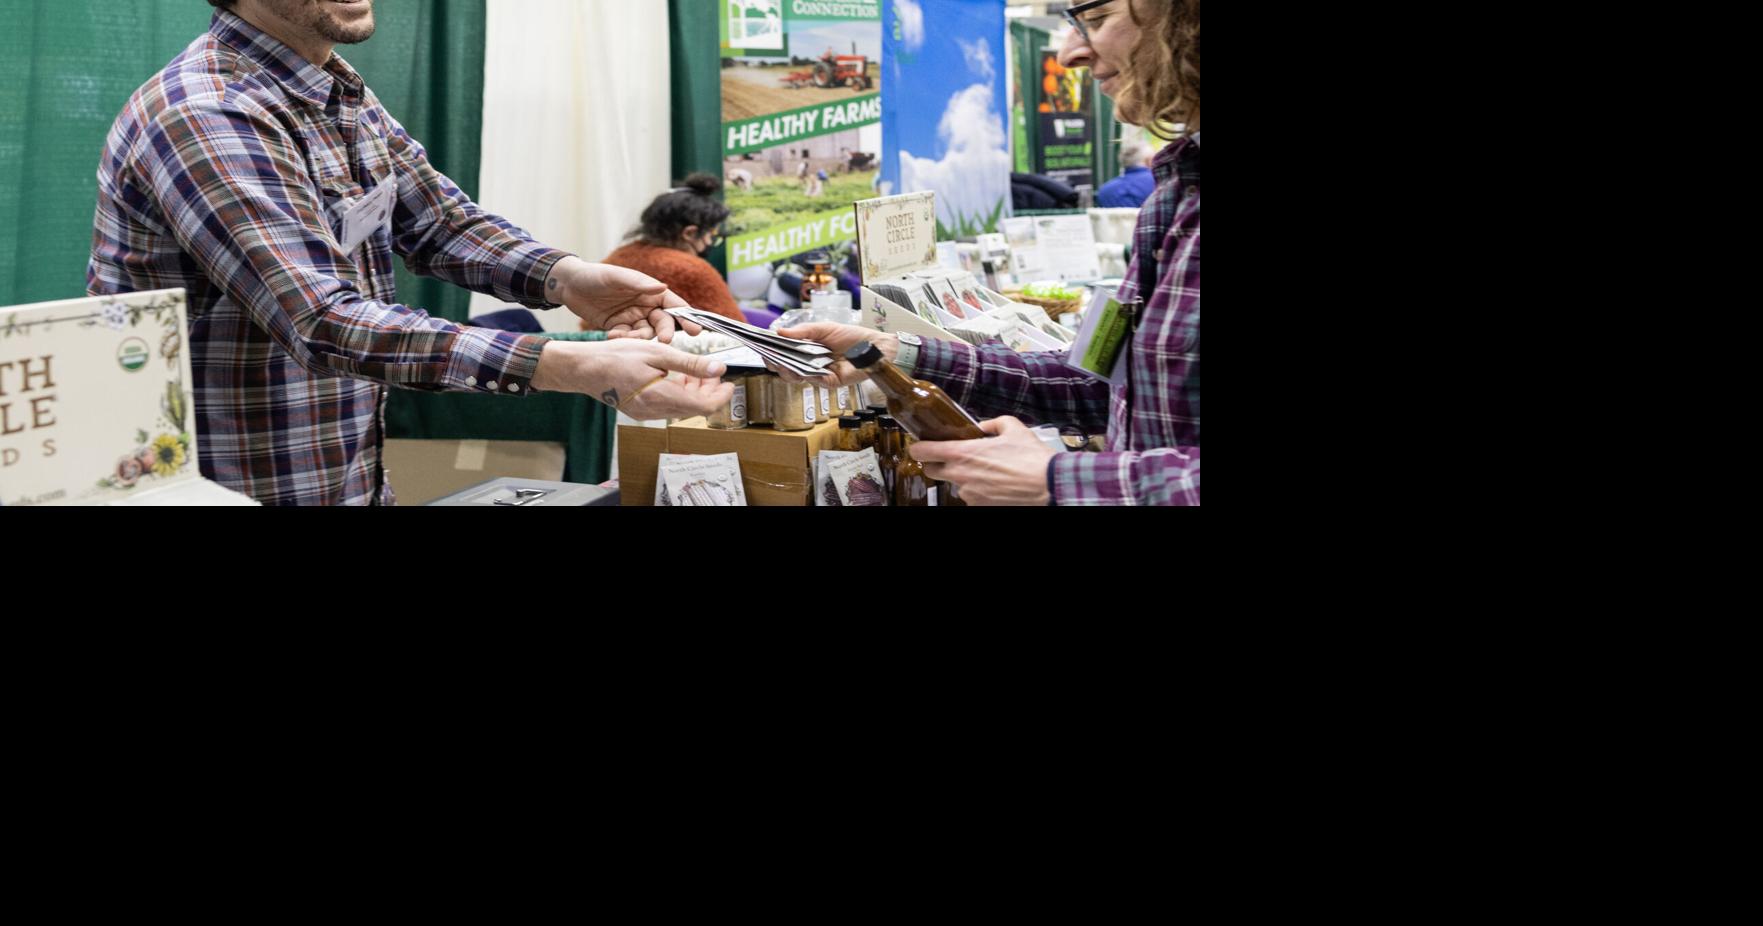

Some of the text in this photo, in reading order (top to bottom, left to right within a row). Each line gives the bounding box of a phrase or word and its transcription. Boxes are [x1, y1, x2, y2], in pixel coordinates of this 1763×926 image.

[727, 96, 882, 150] HEALTHY FARMS
[886, 212, 915, 230] NORTH
[886, 227, 916, 244] CIRCLE
[731, 222, 825, 265] HEALTHY
[0, 394, 57, 436] LE
